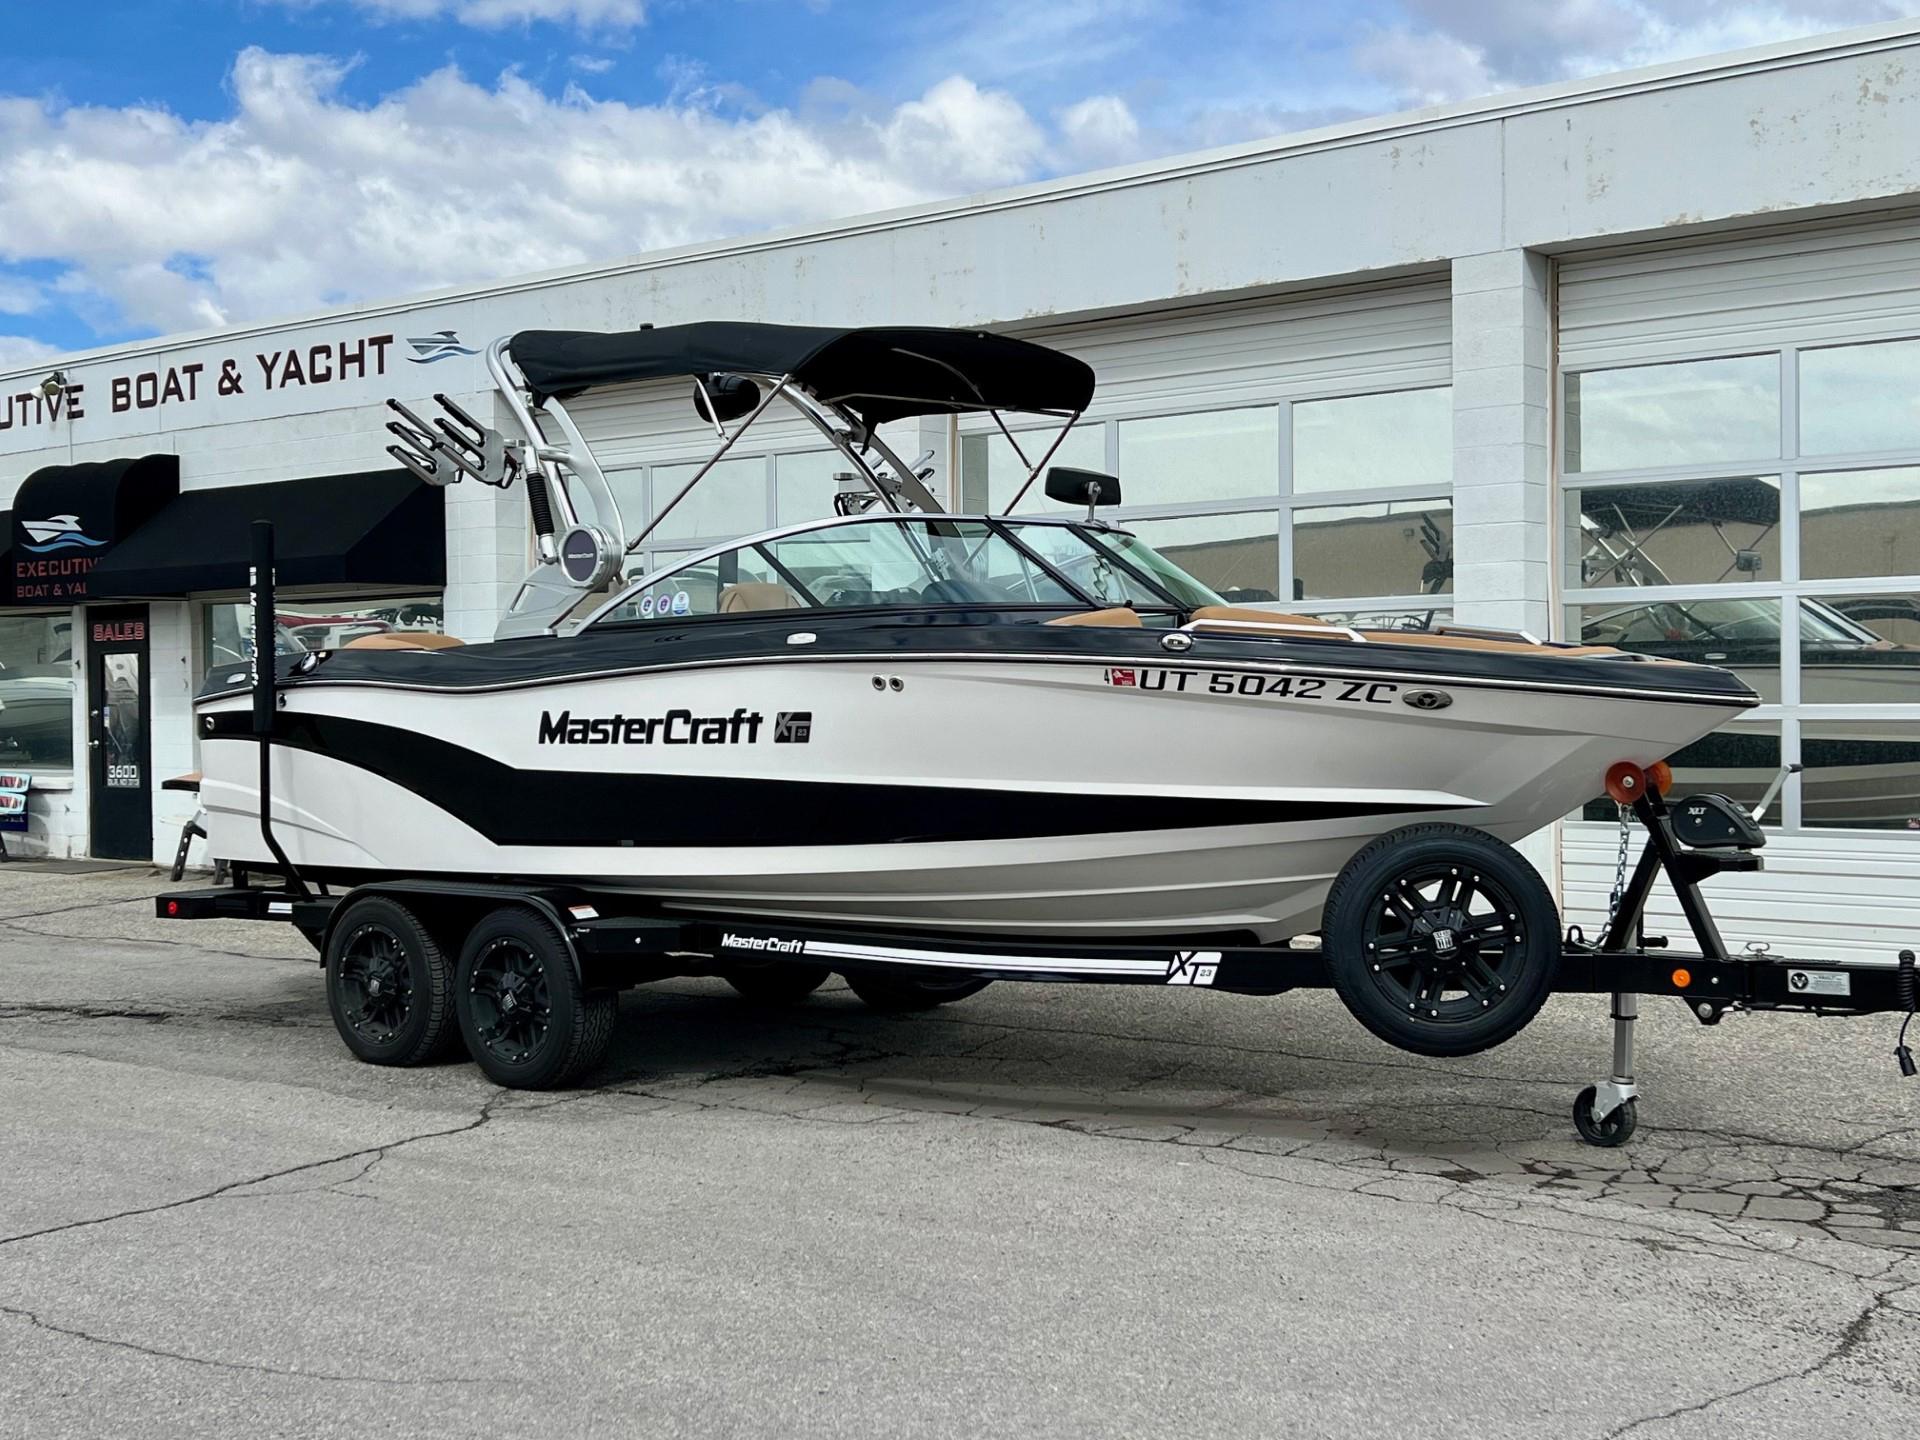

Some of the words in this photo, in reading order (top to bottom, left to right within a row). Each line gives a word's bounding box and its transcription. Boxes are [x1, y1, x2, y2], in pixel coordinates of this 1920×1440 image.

[112, 363, 203, 413] BOAT
[218, 359, 244, 395] &
[256, 334, 394, 390] YACHT
[16, 557, 104, 577] EXECUTIV
[17, 584, 49, 598] BOAT
[53, 584, 63, 596] &
[93, 622, 145, 641] SALES
[1140, 669, 1198, 692] UT
[1208, 674, 1326, 699] 5042
[1336, 681, 1398, 704] ZC
[538, 708, 764, 744] MasterCraft
[108, 765, 137, 778] 3600
[721, 933, 803, 954] MasterCraft
